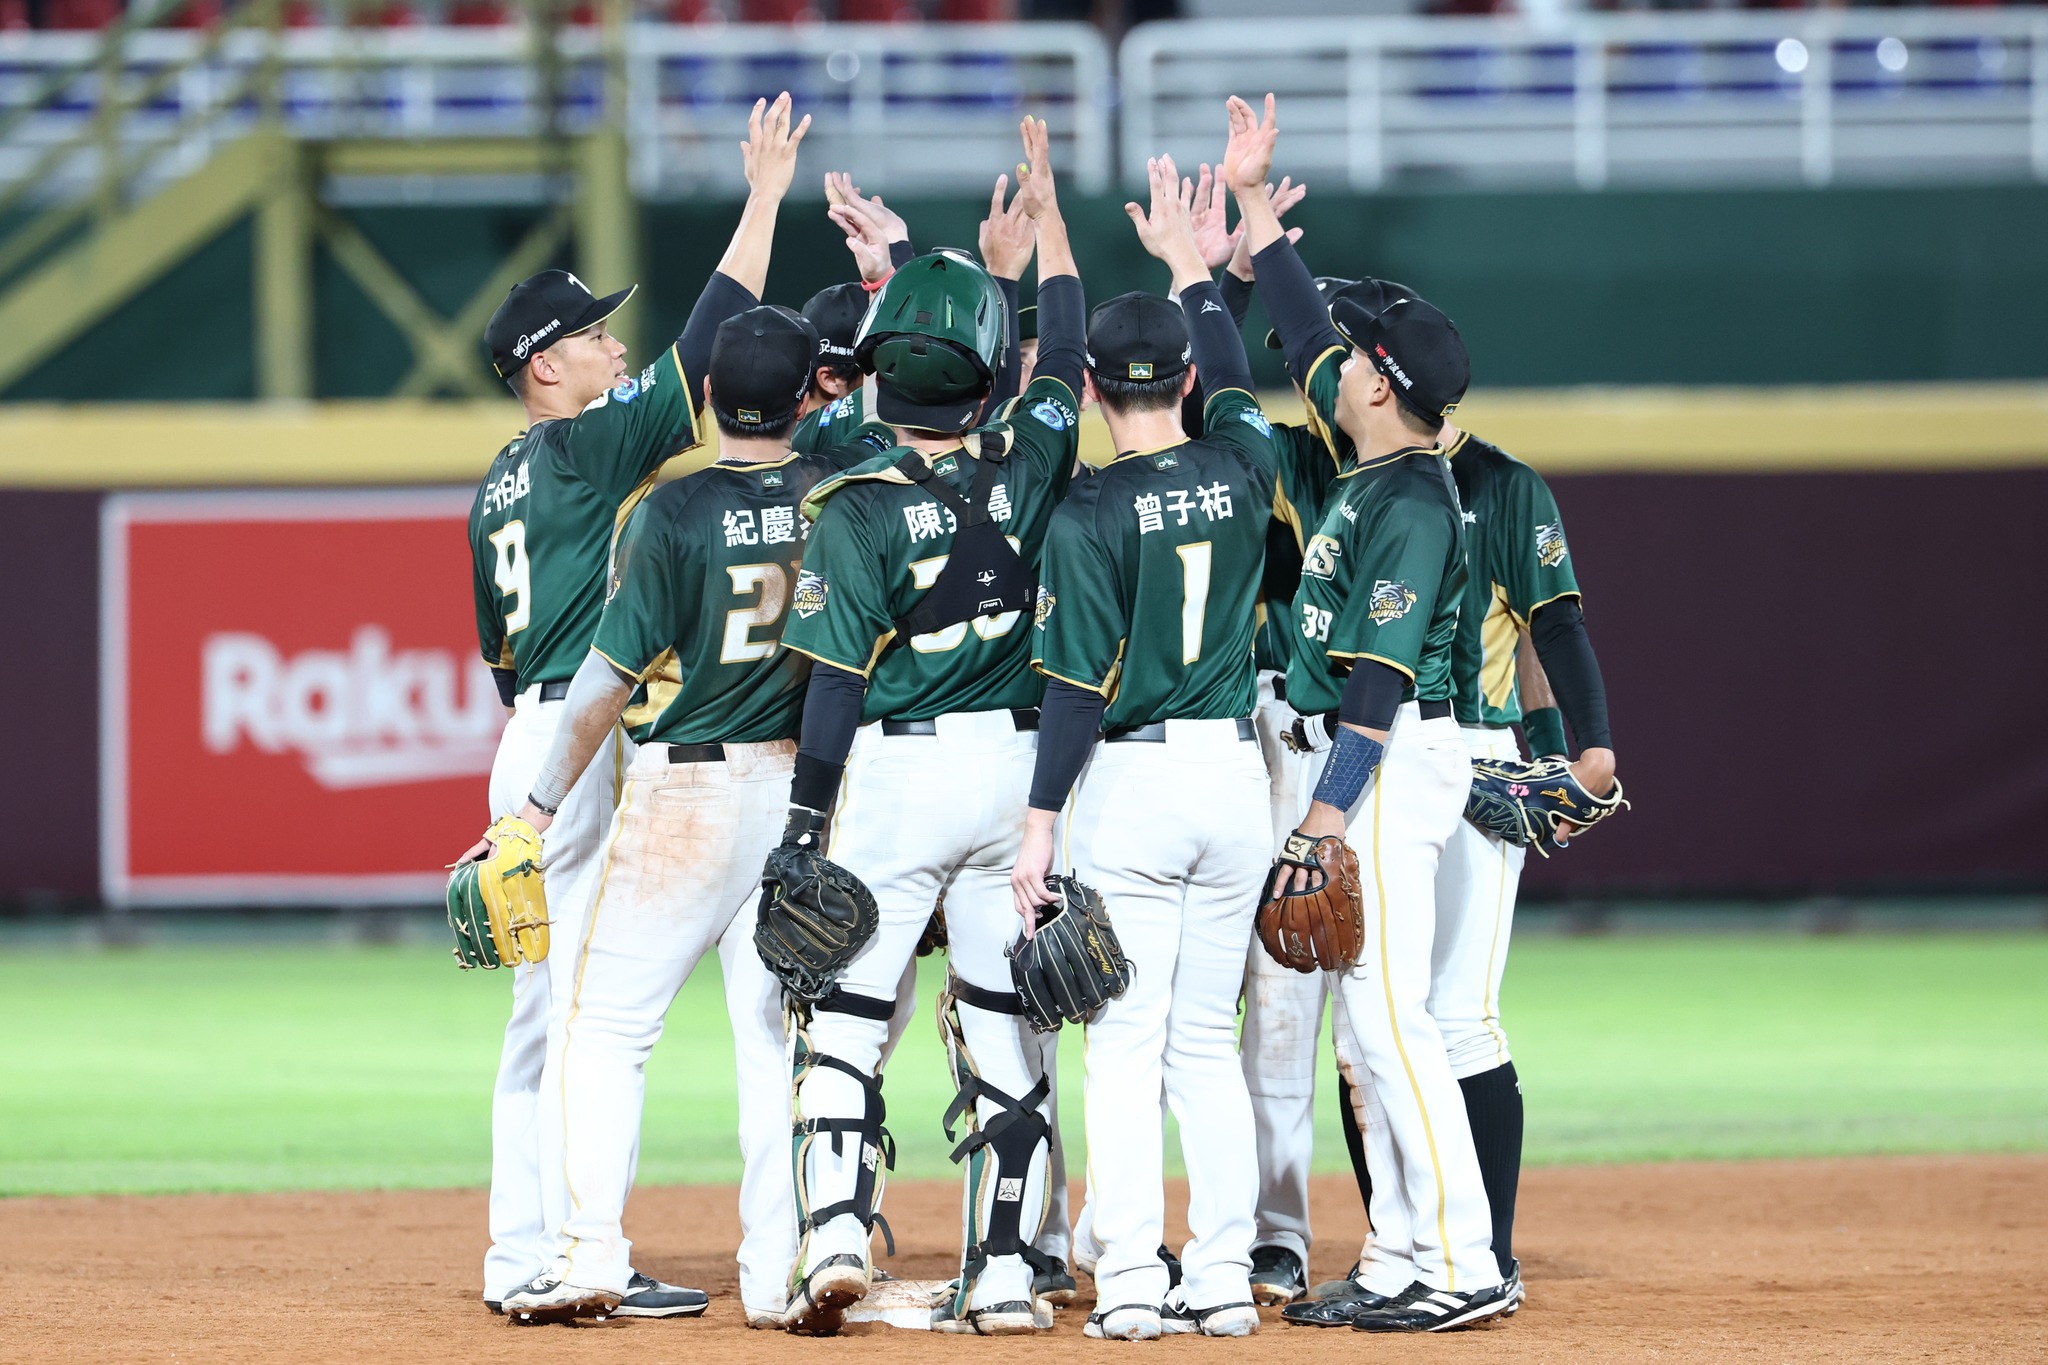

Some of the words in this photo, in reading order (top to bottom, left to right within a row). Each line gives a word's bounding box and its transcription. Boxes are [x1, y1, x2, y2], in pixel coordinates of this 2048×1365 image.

[1134, 481, 1233, 535] 曾子祐
[489, 519, 531, 636] 9
[801, 589, 821, 602] TSG
[720, 560, 803, 665] 2
[792, 601, 824, 611] HAWKS
[1176, 541, 1212, 666] 1
[1301, 603, 1333, 643] 39
[1368, 609, 1404, 620] HAWKS
[1378, 598, 1397, 609] TSG
[204, 622, 507, 757] Raku
